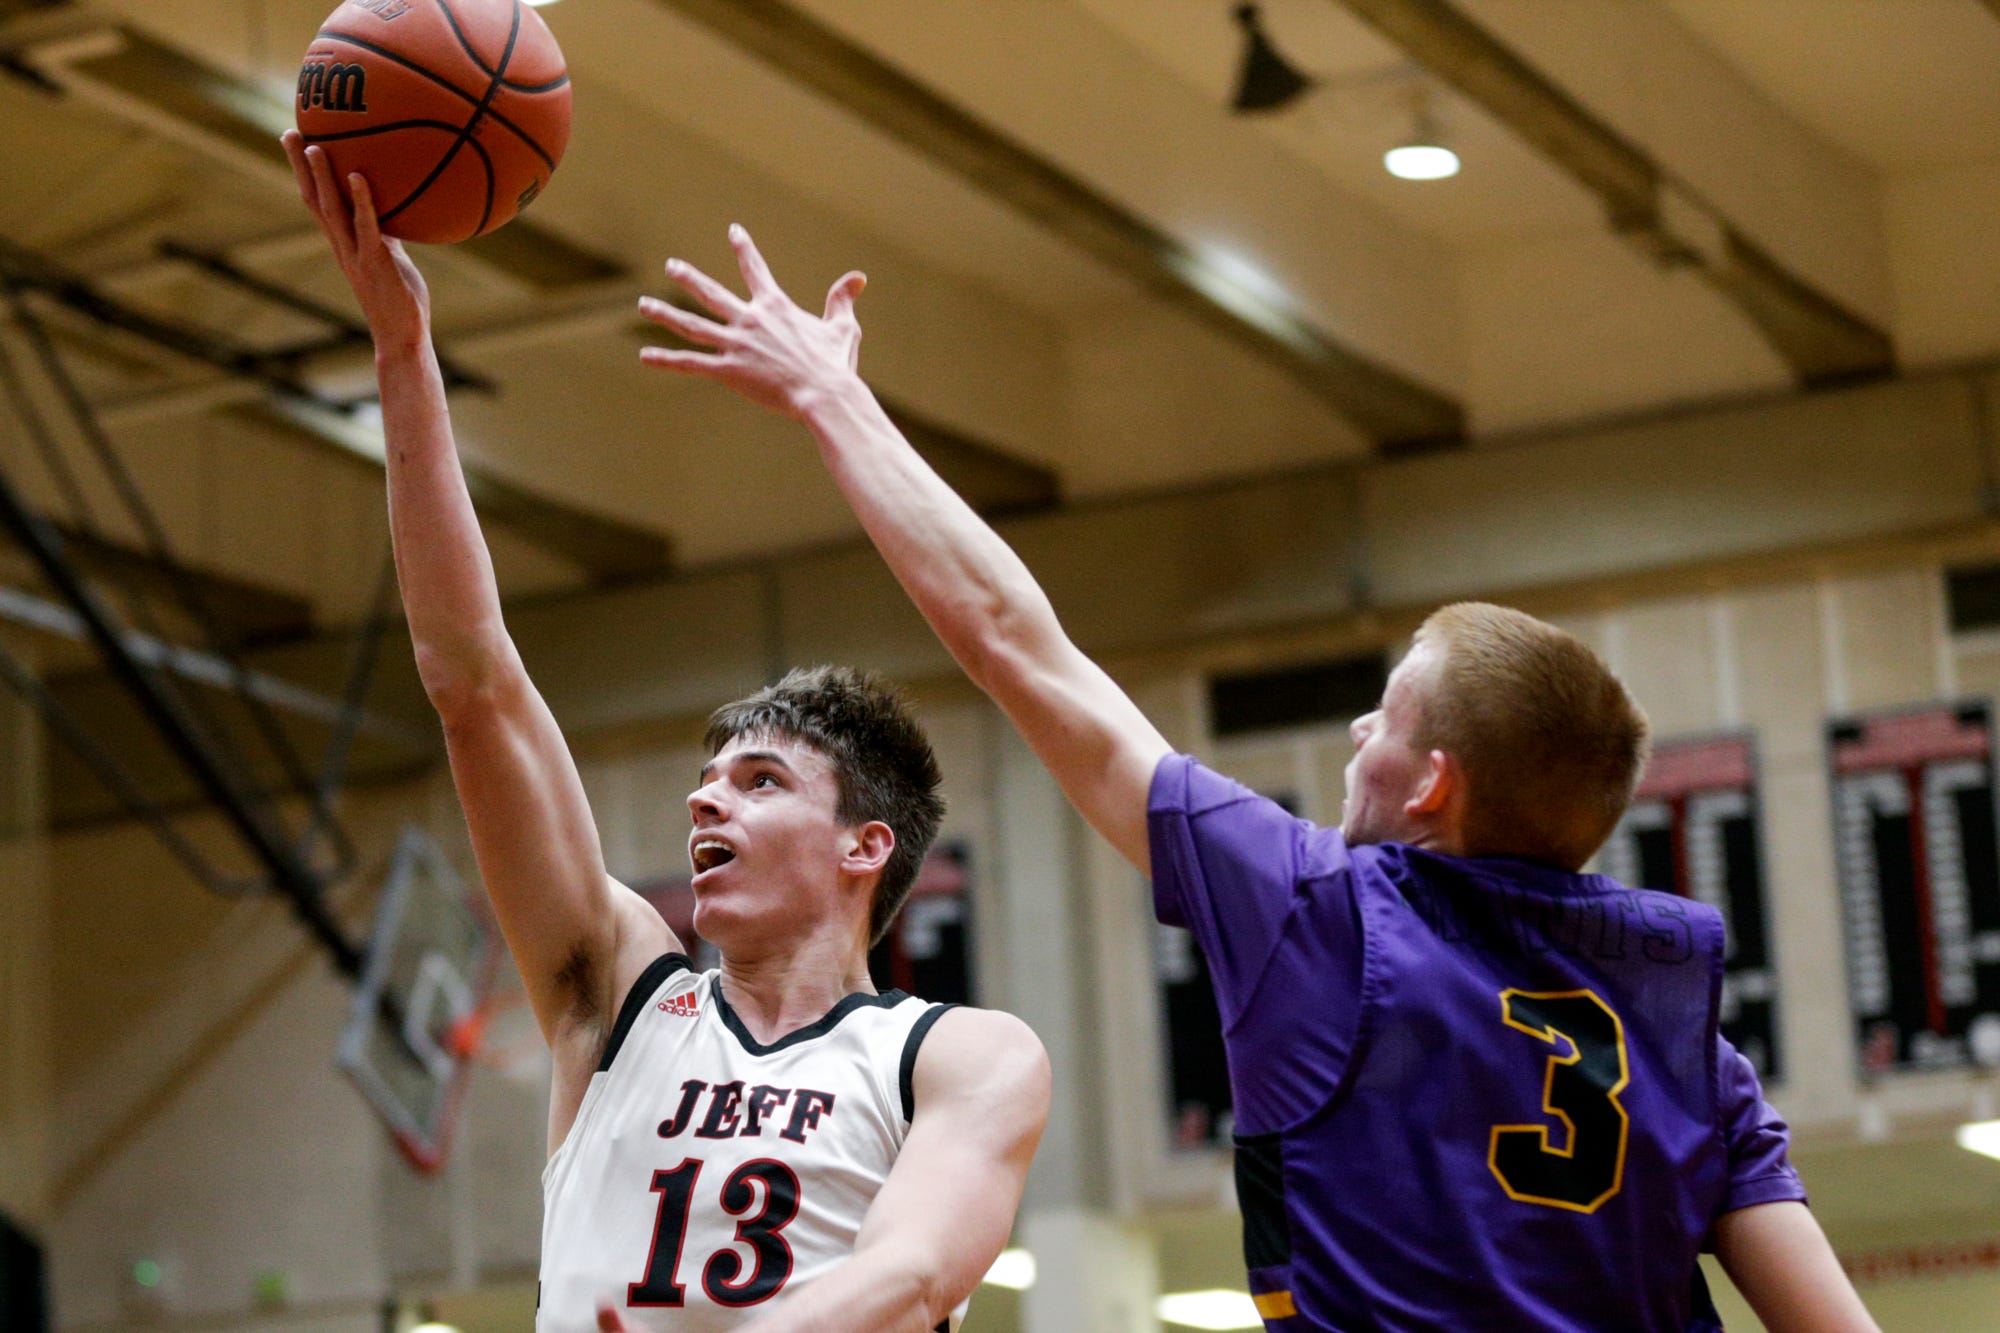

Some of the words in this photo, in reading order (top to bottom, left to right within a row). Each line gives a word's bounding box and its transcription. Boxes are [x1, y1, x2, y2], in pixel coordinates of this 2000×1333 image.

[657, 1002, 700, 1018] adidas
[658, 1080, 835, 1144] JEFF
[1488, 988, 1629, 1213] 3
[626, 1157, 801, 1308] 13
